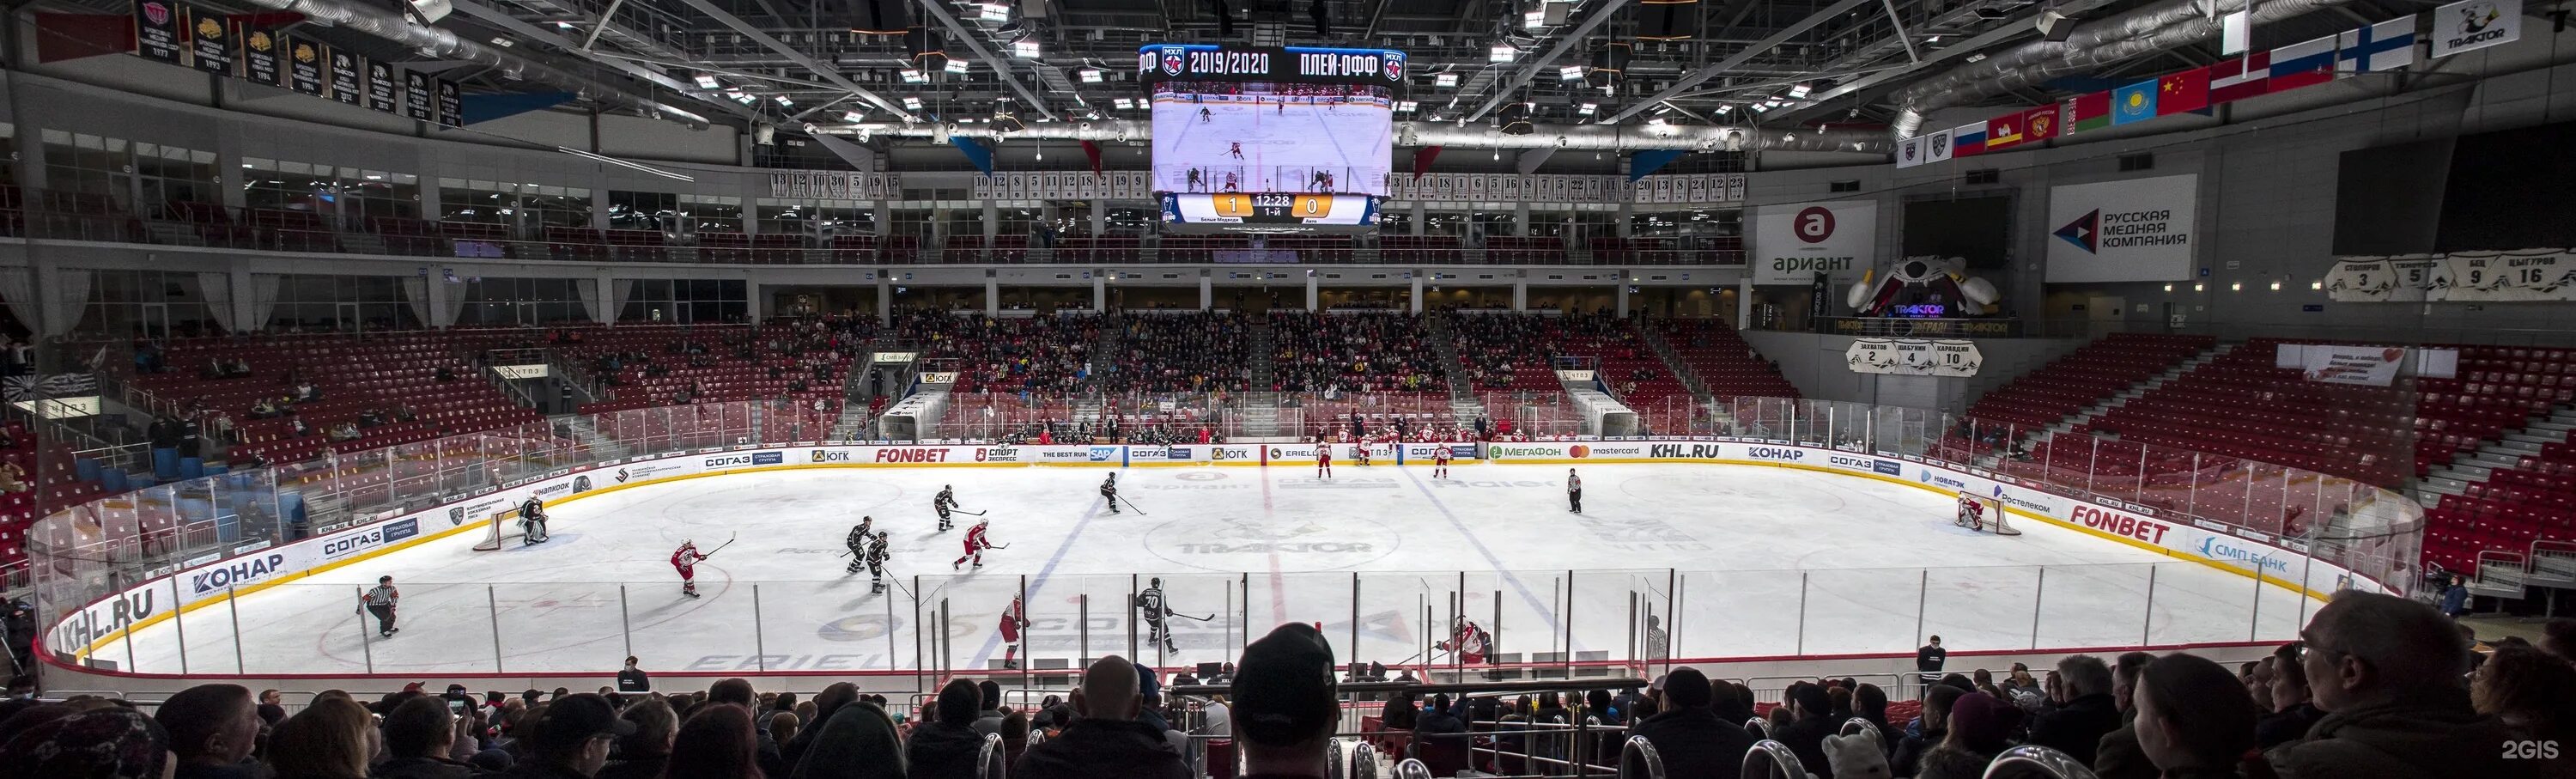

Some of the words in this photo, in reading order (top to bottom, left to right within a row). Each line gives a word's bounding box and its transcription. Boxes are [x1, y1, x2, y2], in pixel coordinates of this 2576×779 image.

[2447, 28, 2505, 49] TRAKTOR
[153, 47, 168, 58] 1977
[205, 59, 221, 70] 1993
[1191, 51, 1269, 75] 2019/2020
[1301, 53, 1378, 76] ПЛЕЙ-ОФФ
[257, 71, 271, 81] 1994
[301, 82, 314, 91] 1994
[775, 174, 786, 185] 13
[794, 175, 805, 186] 12
[813, 176, 824, 186] 10
[831, 176, 844, 187] 30
[854, 176, 860, 186] 5
[868, 177, 880, 187] 19
[887, 176, 898, 187] 15
[976, 177, 987, 186] 10
[993, 177, 1005, 186] 12
[1014, 177, 1020, 186] 8
[1032, 177, 1037, 186] 5
[1046, 177, 1058, 186] 11
[1064, 177, 1075, 186] 12
[1081, 177, 1092, 186] 18
[1101, 177, 1107, 186] 2
[1116, 177, 1127, 186] 19
[1135, 177, 1141, 186] 9
[1406, 178, 1416, 187] 11
[1422, 178, 1433, 187] 14
[1438, 178, 1450, 188] 18
[1459, 178, 1463, 187] 1
[1475, 178, 1480, 187] 6
[1492, 179, 1498, 188] 5
[1505, 178, 1516, 188] 16
[1524, 179, 1530, 188] 8
[1541, 180, 1546, 188] 7
[1558, 180, 1564, 189] 5
[1571, 180, 1583, 189] 22
[1590, 180, 1595, 189] 7
[1606, 180, 1615, 189] 11
[1711, 180, 1723, 189] 12
[1730, 179, 1743, 188] 23
[1638, 180, 1650, 190] 20
[1656, 180, 1668, 190] 13
[1677, 180, 1683, 190] 8
[1692, 180, 1704, 190] 24
[1230, 197, 1236, 212] 1
[1256, 195, 1289, 206] 12:28
[1307, 198, 1317, 214] 0
[1265, 207, 1280, 216] 1-й
[2105, 210, 2170, 223] РУССКАЯ
[2104, 222, 2166, 235] МЕДНАЯ
[2103, 234, 2187, 247] КОМПАНИЯ
[1773, 257, 1854, 274] ариант
[2470, 259, 2486, 268] БЕЦ
[2509, 257, 2555, 266] ЦЫГУРОВ
[2359, 274, 2367, 286] 3
[2409, 270, 2421, 282] 5
[2471, 270, 2481, 283] 9
[2520, 269, 2542, 283] 16
[1894, 304, 1945, 314] TRAKTOR
[1868, 351, 1875, 362] 2
[1908, 353, 1915, 362] 4
[1947, 354, 1960, 364] 10
[827, 452, 849, 460] ЮГК
[875, 448, 951, 463] FONBET
[1091, 449, 1110, 459] SAP
[1225, 450, 1248, 459] ЮГК
[1650, 444, 1719, 458] KHL.RU
[1749, 447, 1803, 460] КОНАР
[706, 456, 750, 467] СОГАЗ
[1831, 456, 1872, 468] СОГАЗ
[1875, 460, 1899, 469] СТРАХОВАЯ
[1934, 476, 1965, 488] НОВАТЭК
[477, 486, 495, 495] KHL.RU
[447, 494, 464, 502] KHL.RU
[2002, 494, 2050, 513] Ростелеком
[2129, 505, 2150, 514] KHL.RU
[356, 515, 378, 525] KHL.RU
[2070, 505, 2170, 545] FONBET
[321, 523, 345, 533] KHL.RU
[386, 521, 416, 533] СТРАХОВАЯ
[391, 528, 411, 538] ГРУППА
[325, 532, 381, 555] СОГАЗ
[1176, 542, 1374, 554] TRAKTOR
[2215, 545, 2247, 561] СМП
[2251, 552, 2287, 573] БАНК
[160, 565, 171, 575] ЮГ
[193, 553, 283, 593] КОНАР
[1145, 596, 1158, 608] 70
[64, 588, 153, 653] KHL.RU
